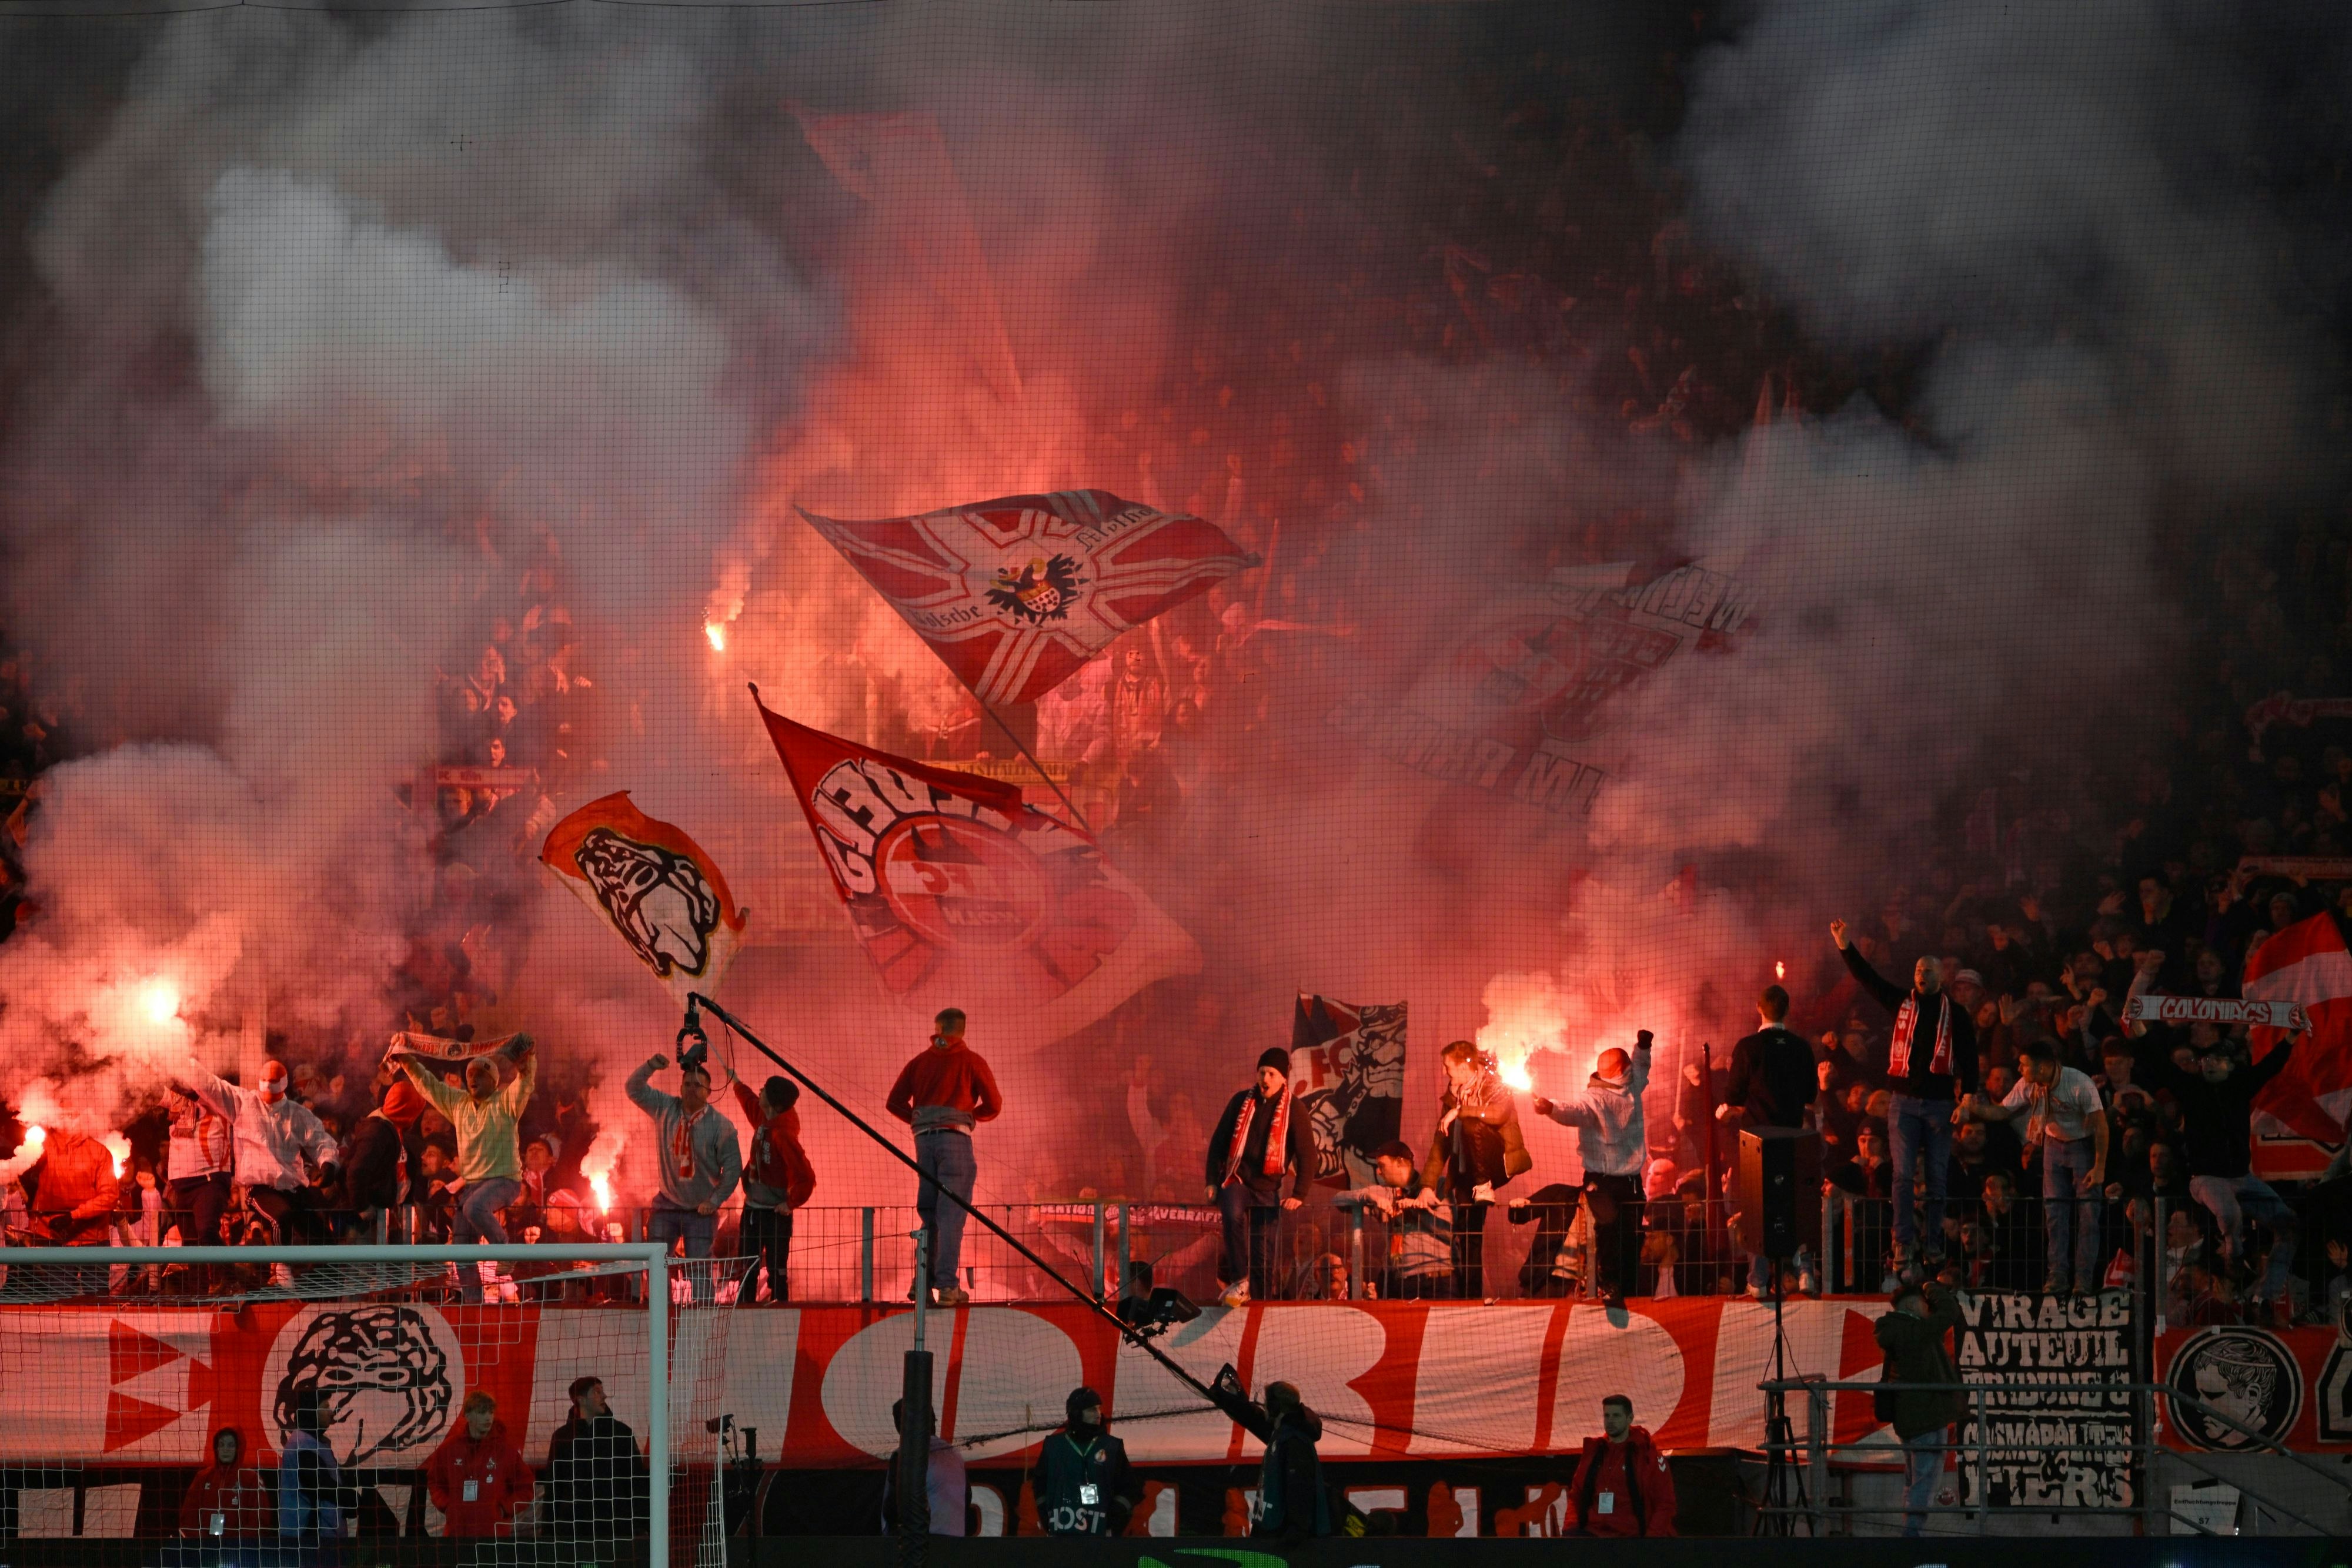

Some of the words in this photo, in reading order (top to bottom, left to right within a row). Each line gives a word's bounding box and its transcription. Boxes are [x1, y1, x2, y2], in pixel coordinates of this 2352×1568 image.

[2162, 998, 2270, 1023] COLONIACS
[1956, 1290, 2129, 1329] VIRAGE
[1959, 1330, 2128, 1368] AUTEUIL
